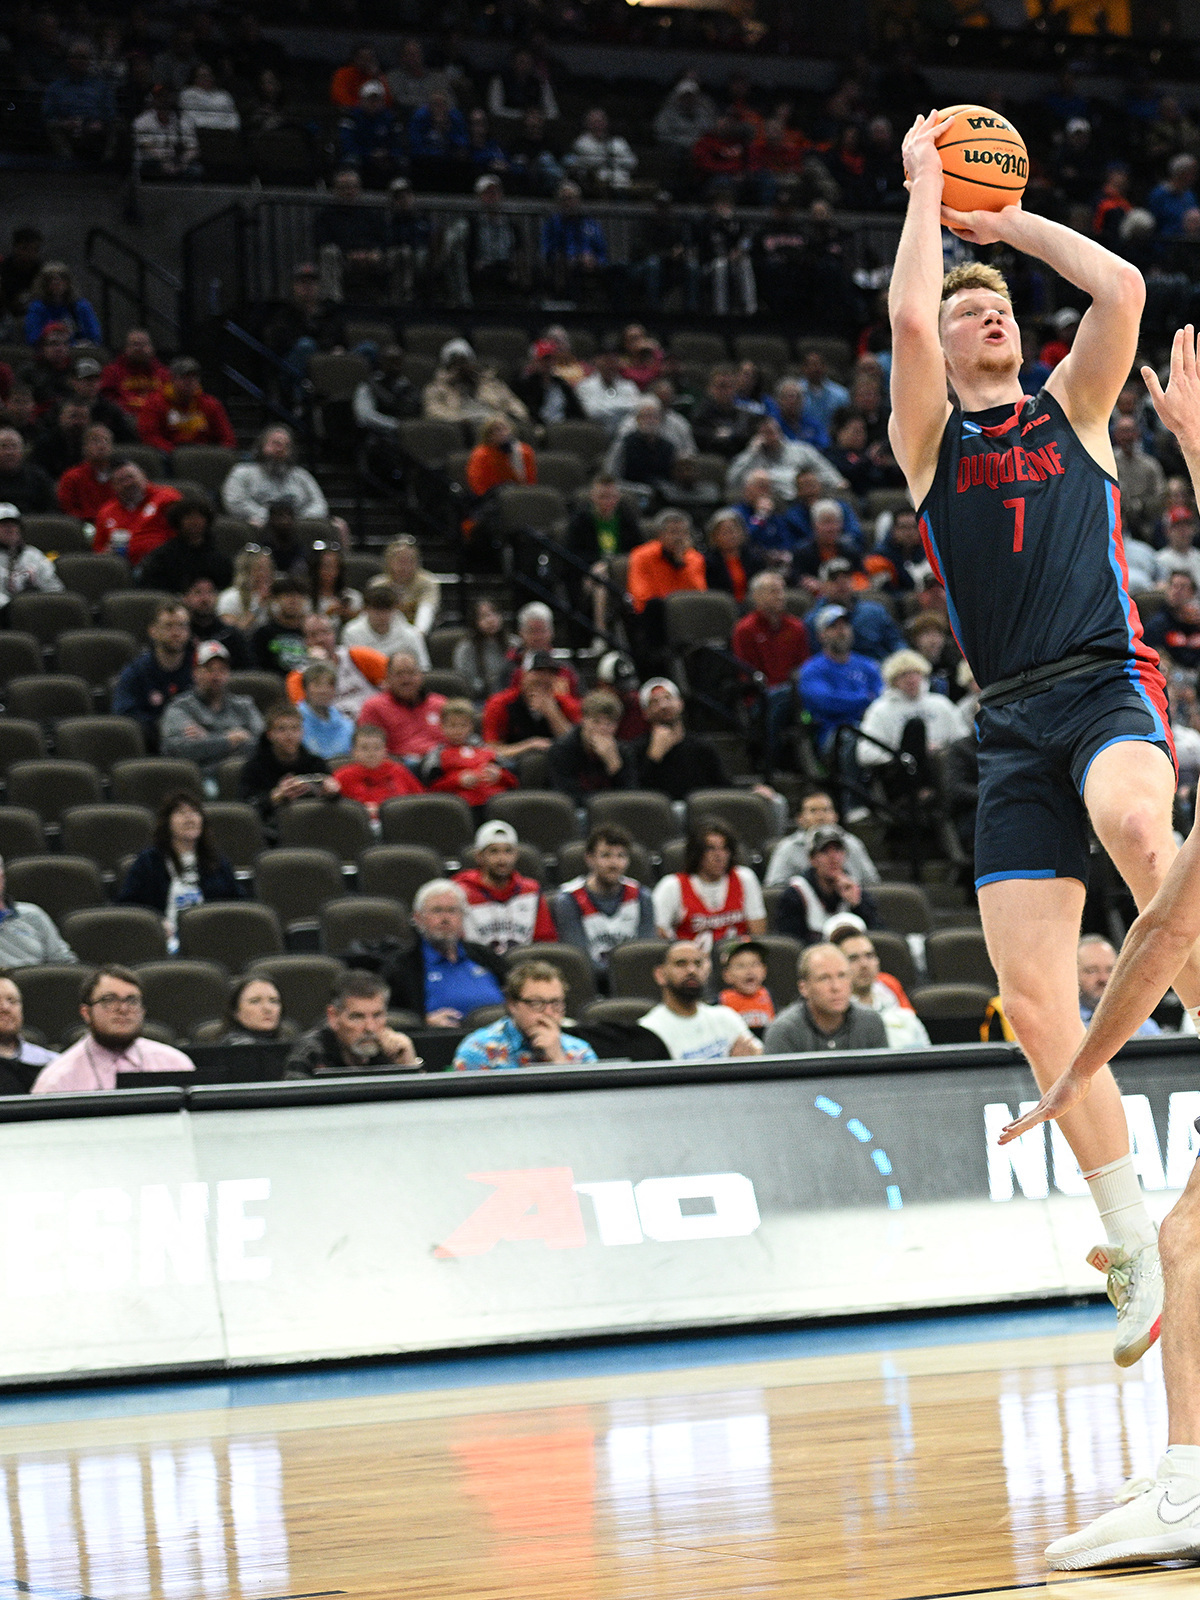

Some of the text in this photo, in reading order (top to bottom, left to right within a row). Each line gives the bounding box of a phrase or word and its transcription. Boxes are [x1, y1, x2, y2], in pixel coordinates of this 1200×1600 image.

[967, 117, 1012, 132] CAA
[964, 150, 1027, 179] Wilson
[957, 441, 1066, 494] DUQUESNE
[1003, 497, 1026, 553] 7
[434, 1166, 762, 1259] A10
